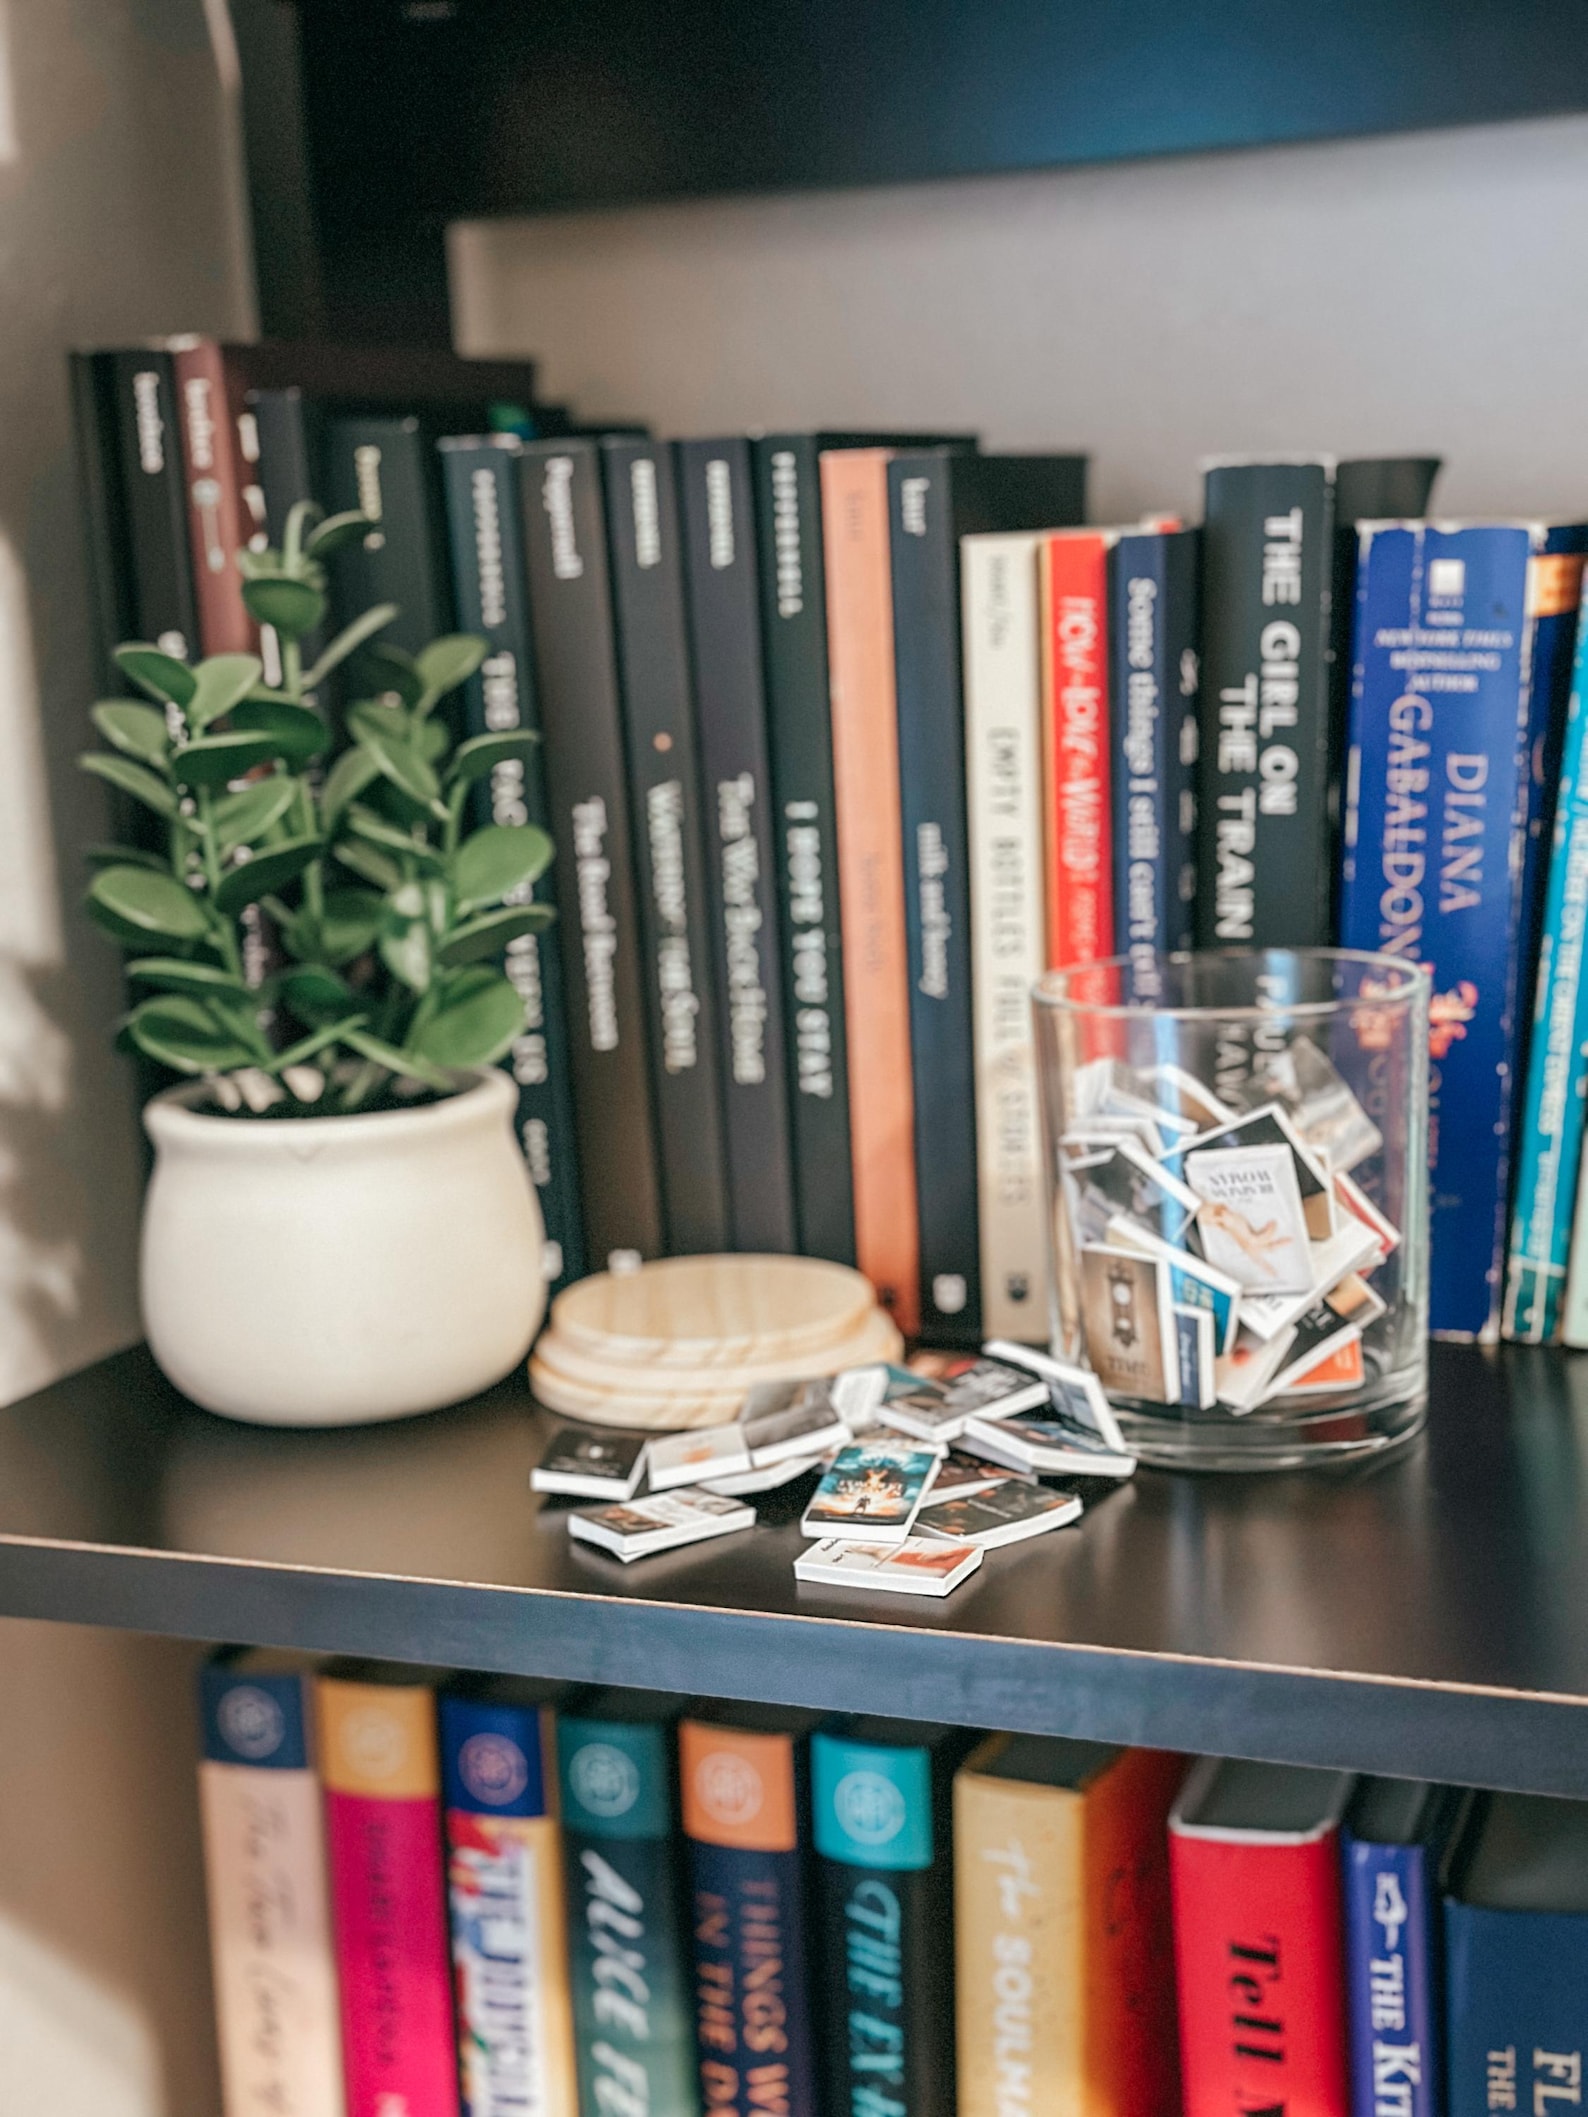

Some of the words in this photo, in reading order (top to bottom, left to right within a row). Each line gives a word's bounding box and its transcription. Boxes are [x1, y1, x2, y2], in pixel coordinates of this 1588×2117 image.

[1262, 507, 1303, 606] THE
[1128, 577, 1158, 668] Some
[1123, 672, 1160, 776] things
[1218, 672, 1258, 773] THE
[1260, 620, 1301, 737] GIRL
[988, 727, 1022, 817] EMPTY
[1128, 778, 1159, 791] I
[1259, 744, 1299, 815] ON
[917, 822, 949, 878] milk
[1129, 793, 1160, 857] still
[1215, 786, 1255, 938] TRAIN
[1379, 692, 1433, 958] GABALDON
[1439, 750, 1489, 912] DIANA
[786, 827, 823, 922] HOPE
[991, 837, 1026, 959] BOTTLES
[1129, 859, 1160, 938] can't
[792, 929, 828, 1003] YOU
[997, 975, 1026, 1043] FULL
[796, 1009, 833, 1097] STAY
[580, 1848, 651, 2039] ALICE
[741, 1878, 787, 2054] THINGS
[844, 1879, 902, 2006] THE
[696, 1959, 737, 2048] THE
[1228, 1935, 1287, 2063] Tell
[1370, 1953, 1407, 2031] THE
[1487, 2044, 1517, 2110] THE
